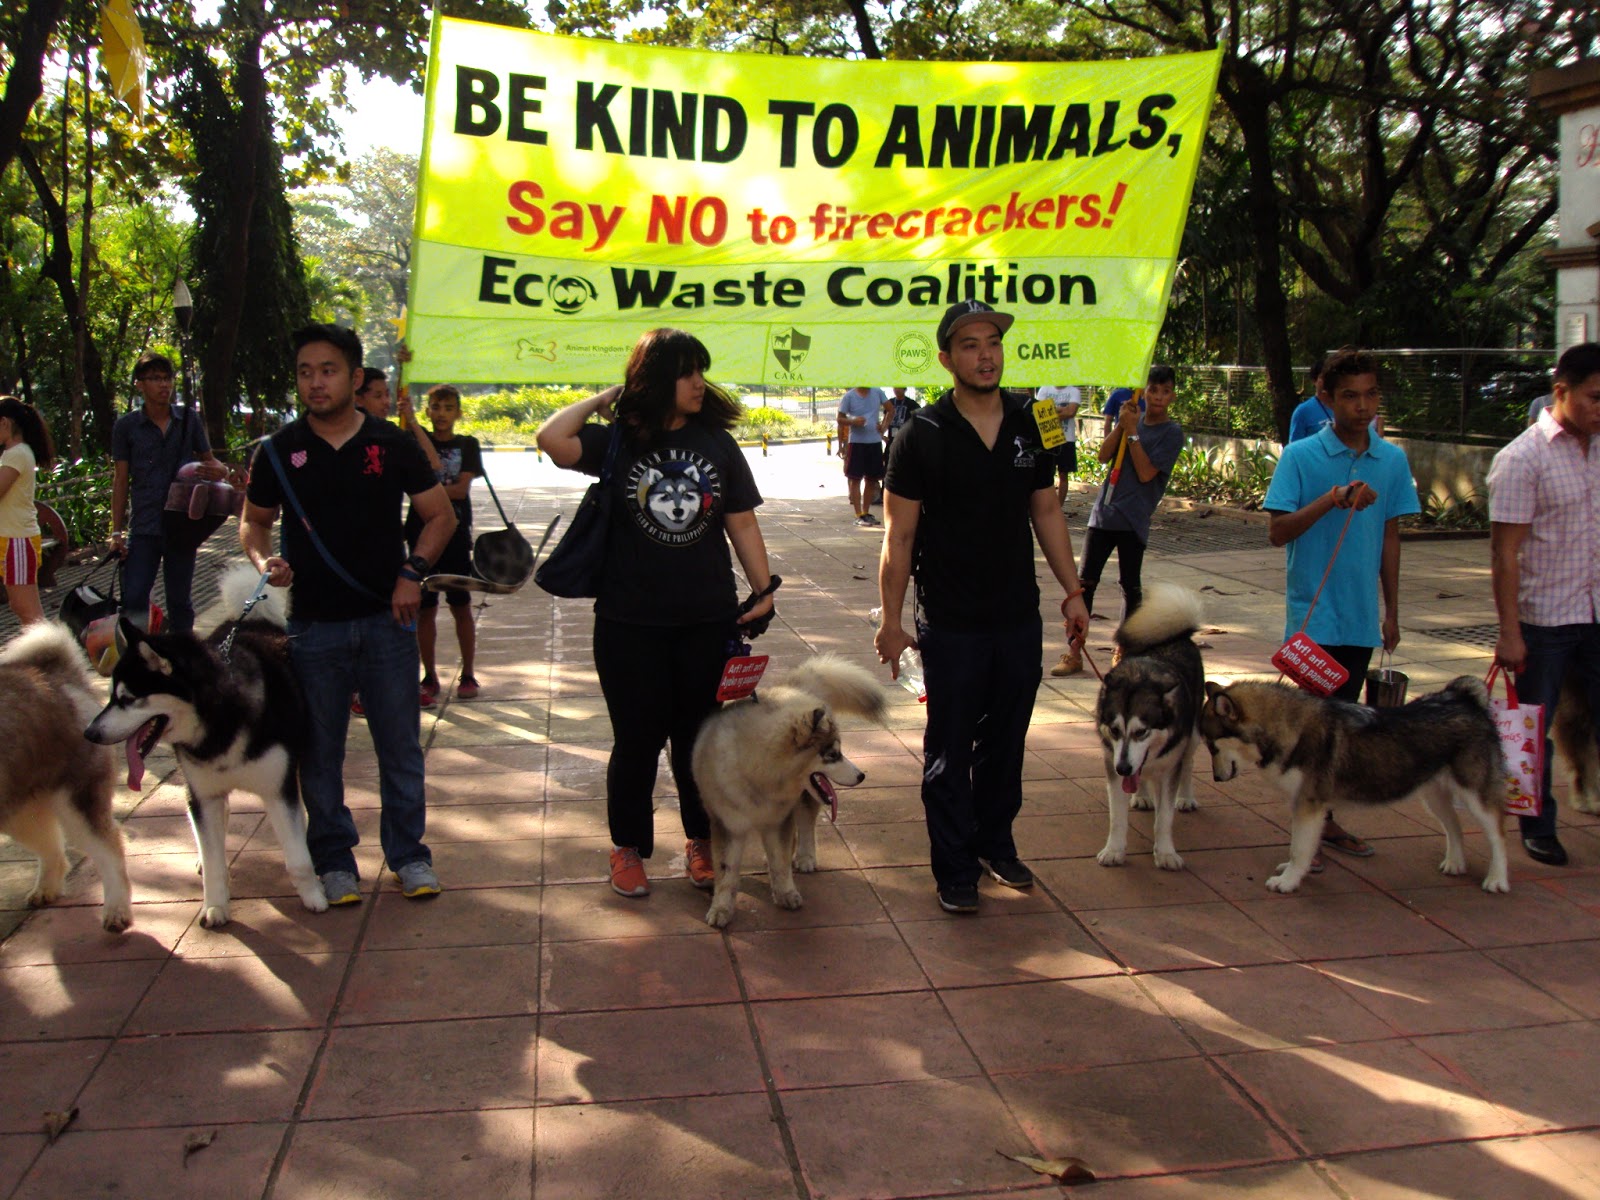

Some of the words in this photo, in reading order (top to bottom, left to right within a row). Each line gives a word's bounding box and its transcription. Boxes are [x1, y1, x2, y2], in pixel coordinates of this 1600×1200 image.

[454, 64, 548, 146] BE
[575, 80, 749, 164] KIND
[768, 99, 860, 170] TO
[874, 93, 1183, 170] ANIMALS,
[506, 180, 626, 253] Say
[646, 194, 729, 248] NO
[746, 207, 798, 246] to
[809, 181, 1129, 243] firecrackers!
[610, 267, 807, 311] Waste
[826, 262, 1098, 308] Coalition
[592, 345, 623, 353] Kingdom
[900, 348, 928, 358] PAWS
[1017, 342, 1071, 361] CARE
[774, 371, 804, 381] CARA
[669, 449, 721, 498] MALAMUTE
[1280, 645, 1301, 666] Ayoko
[1299, 662, 1310, 674] ng
[1305, 669, 1337, 692] paputok!
[1292, 639, 1312, 656] Arf!
[1308, 654, 1327, 670] arf!
[1324, 667, 1342, 682] arf!
